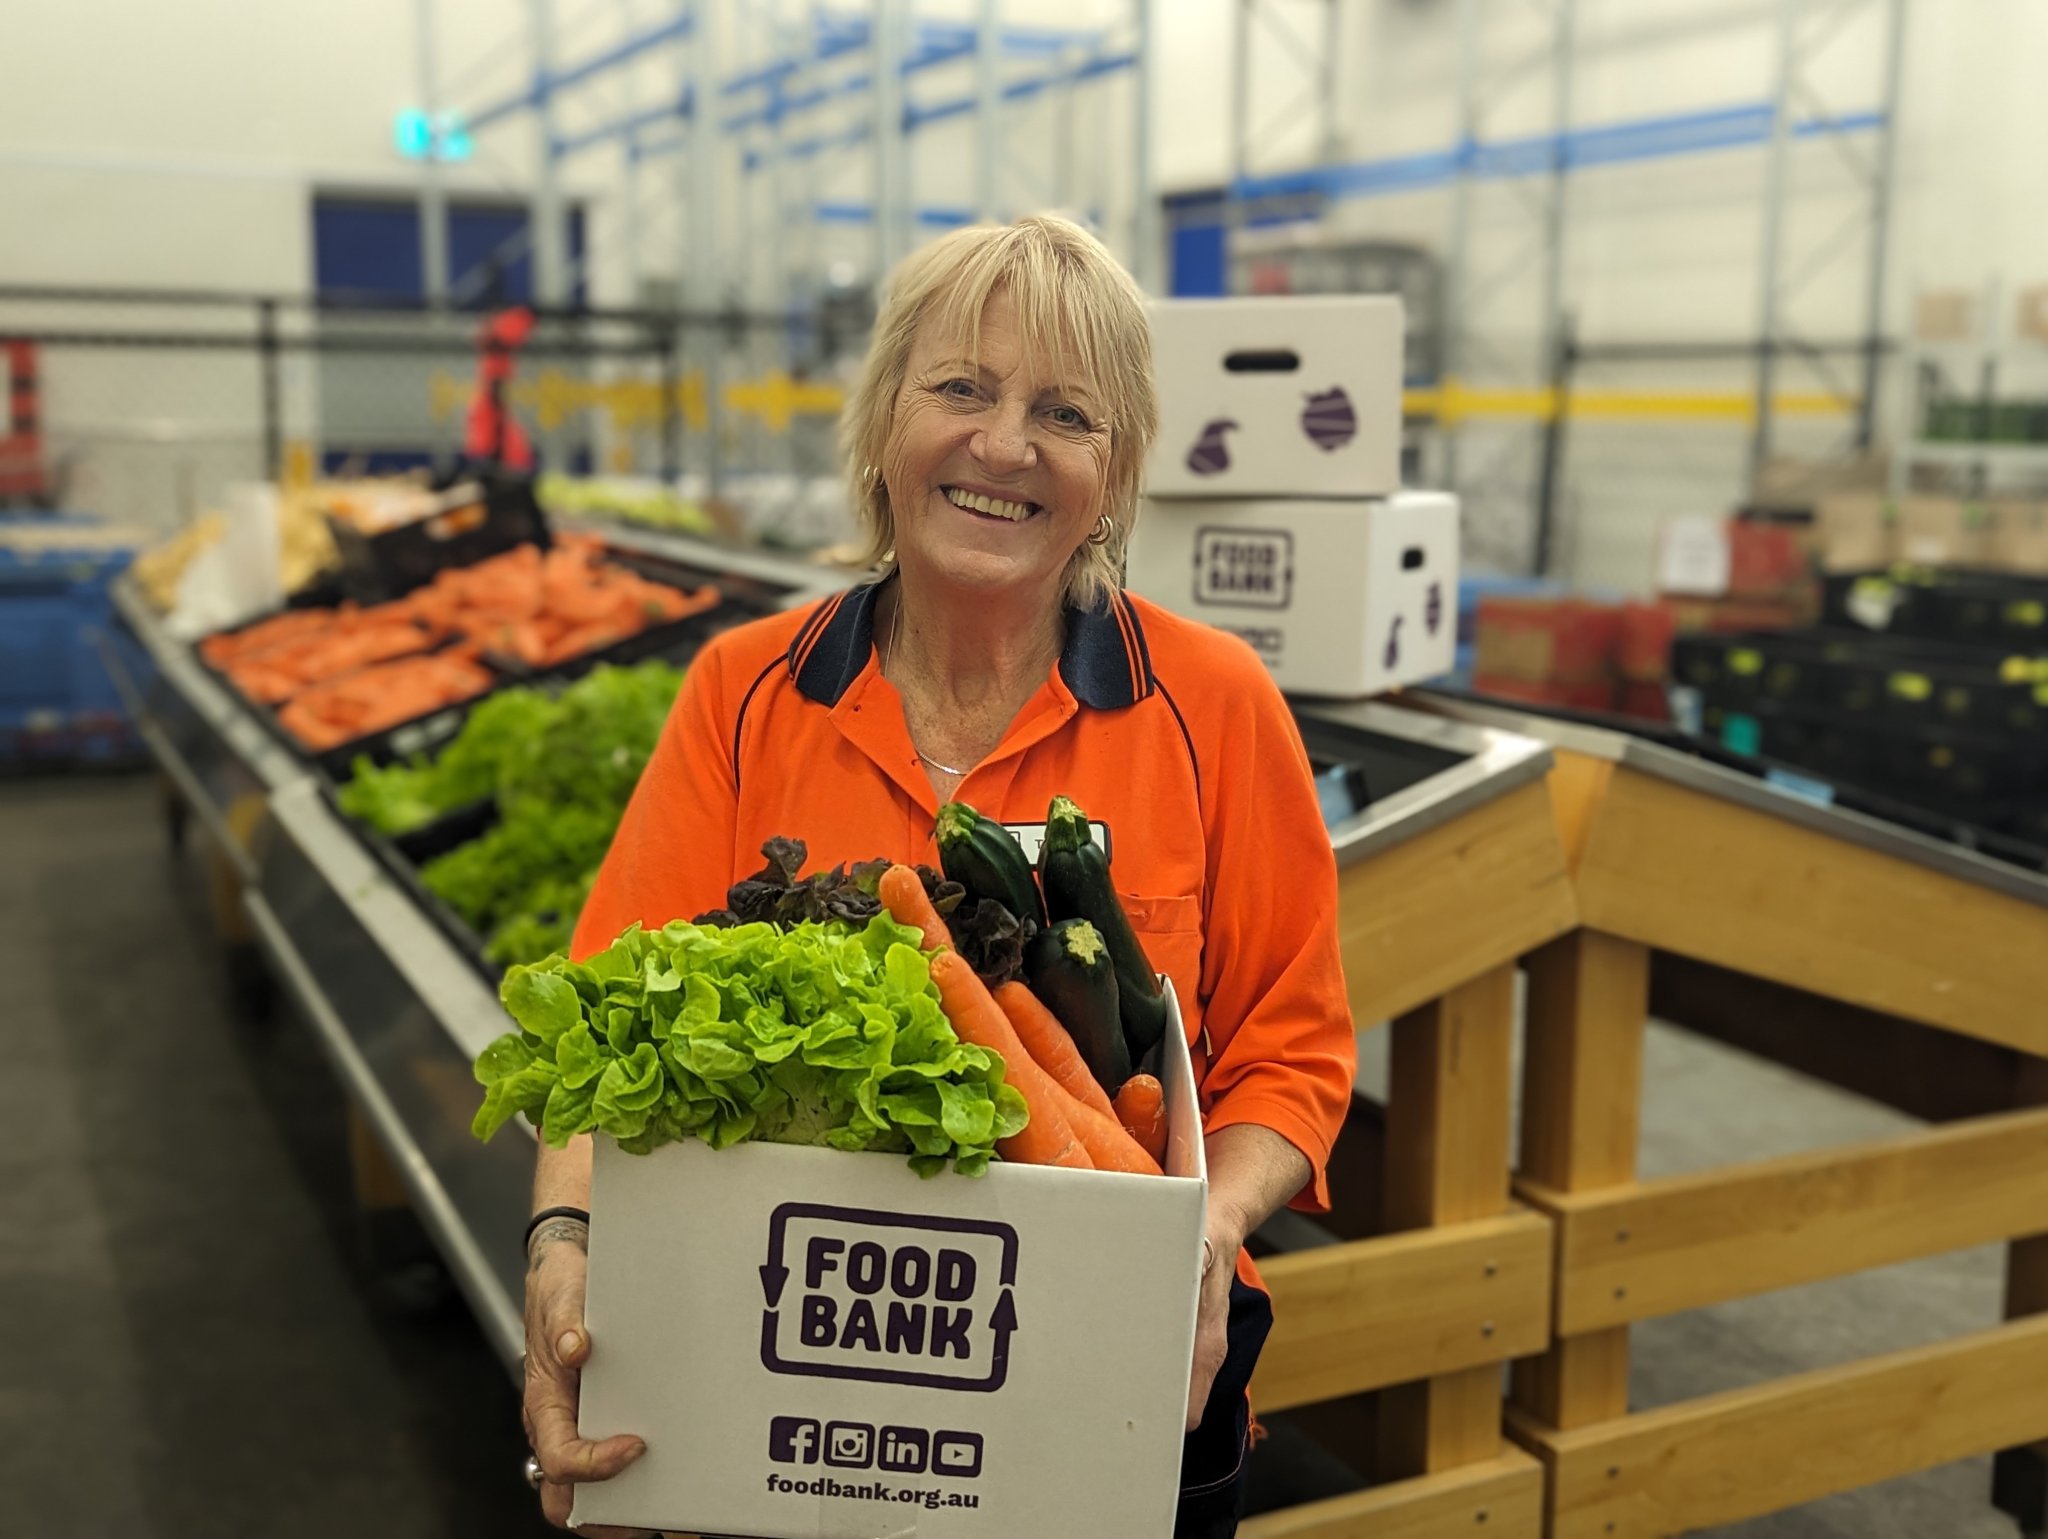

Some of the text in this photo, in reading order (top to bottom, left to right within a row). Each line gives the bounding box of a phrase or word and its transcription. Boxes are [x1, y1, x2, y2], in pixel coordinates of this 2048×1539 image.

[1209, 541, 1277, 567] FOOD
[1208, 569, 1275, 594] BANK
[805, 1236, 977, 1303] FOOD
[799, 1294, 973, 1360] BANK
[766, 1473, 980, 1510] foodbank.org.au
